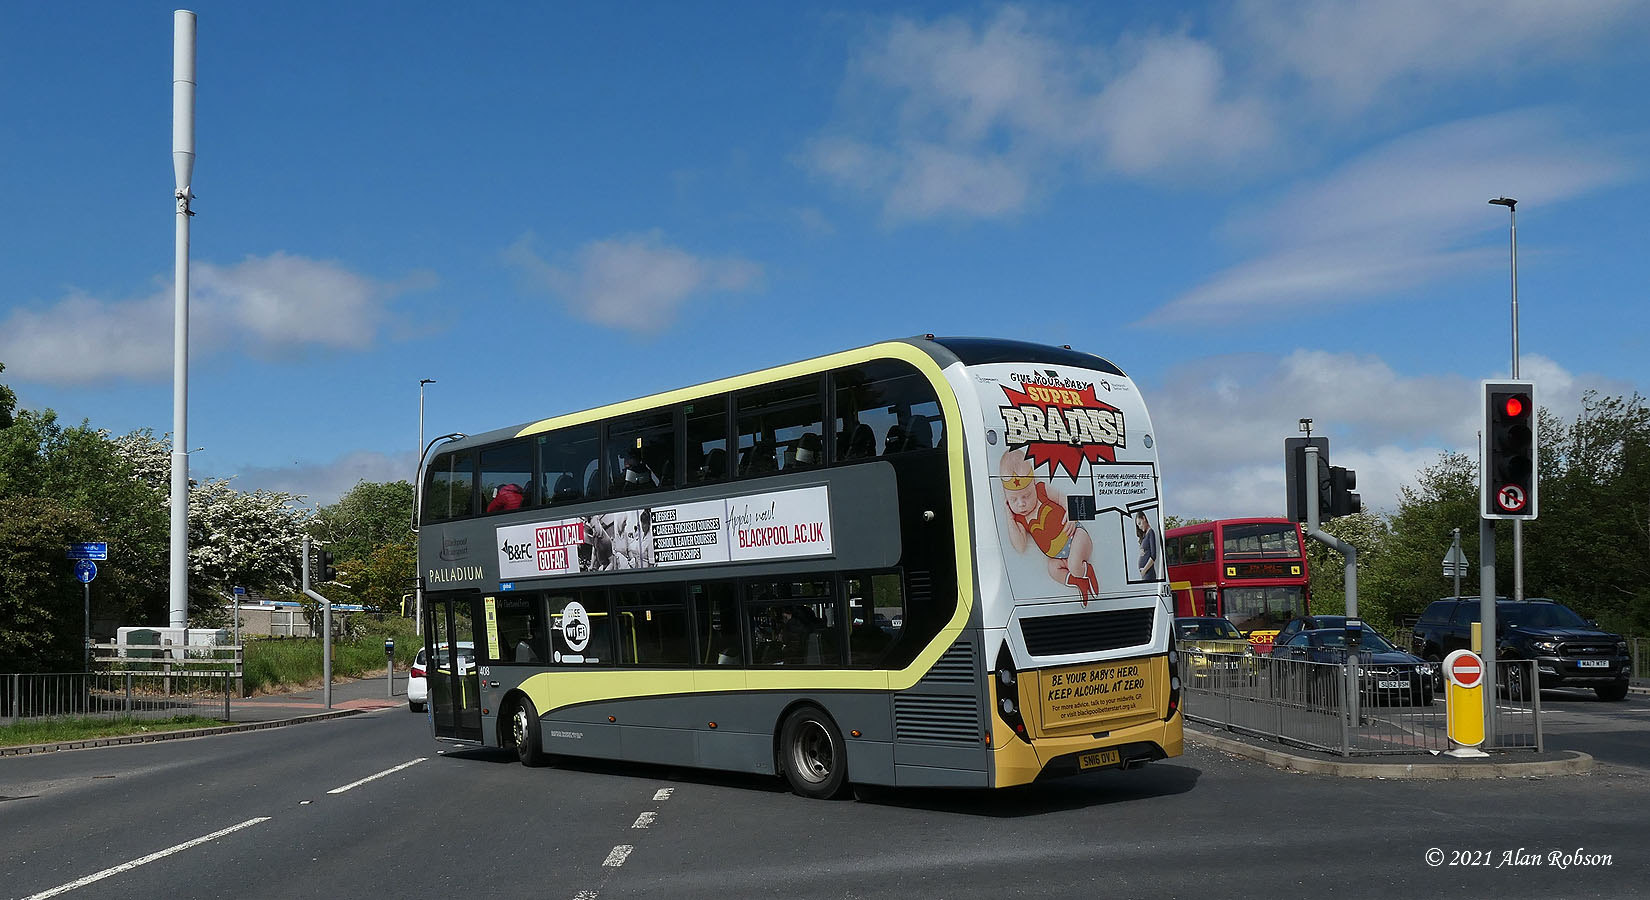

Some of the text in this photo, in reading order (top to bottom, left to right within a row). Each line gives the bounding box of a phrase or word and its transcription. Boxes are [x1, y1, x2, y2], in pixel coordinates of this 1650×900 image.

[1010, 372, 1034, 384] GIVE
[1034, 375, 1062, 387] YOUR
[1063, 378, 1089, 391] BABY
[1027, 386, 1084, 406] SUPER
[1001, 405, 1126, 447] BRAINS!
[697, 519, 720, 530] COURSES
[725, 501, 775, 536] Apply now!
[537, 527, 557, 548] STAY
[657, 533, 716, 549] SCHOOL LEAVER COURSES
[738, 522, 824, 548] BLACKPOOL.AC.UK
[508, 543, 533, 561] B&FC
[538, 550, 568, 570] GO FAR.
[429, 566, 484, 583] PALLADIUM
[479, 666, 490, 676] 408
[1051, 674, 1063, 687] BE
[1066, 672, 1087, 684] YOUR
[1089, 668, 1115, 682] BABY'S
[1047, 678, 1145, 701] KEEP ALCOHOL AT ZERO
[1077, 703, 1136, 717] blackpoolbetterstart.org.uk
[1105, 698, 1116, 706] your
[1083, 751, 1116, 767] SN16 OVJ
